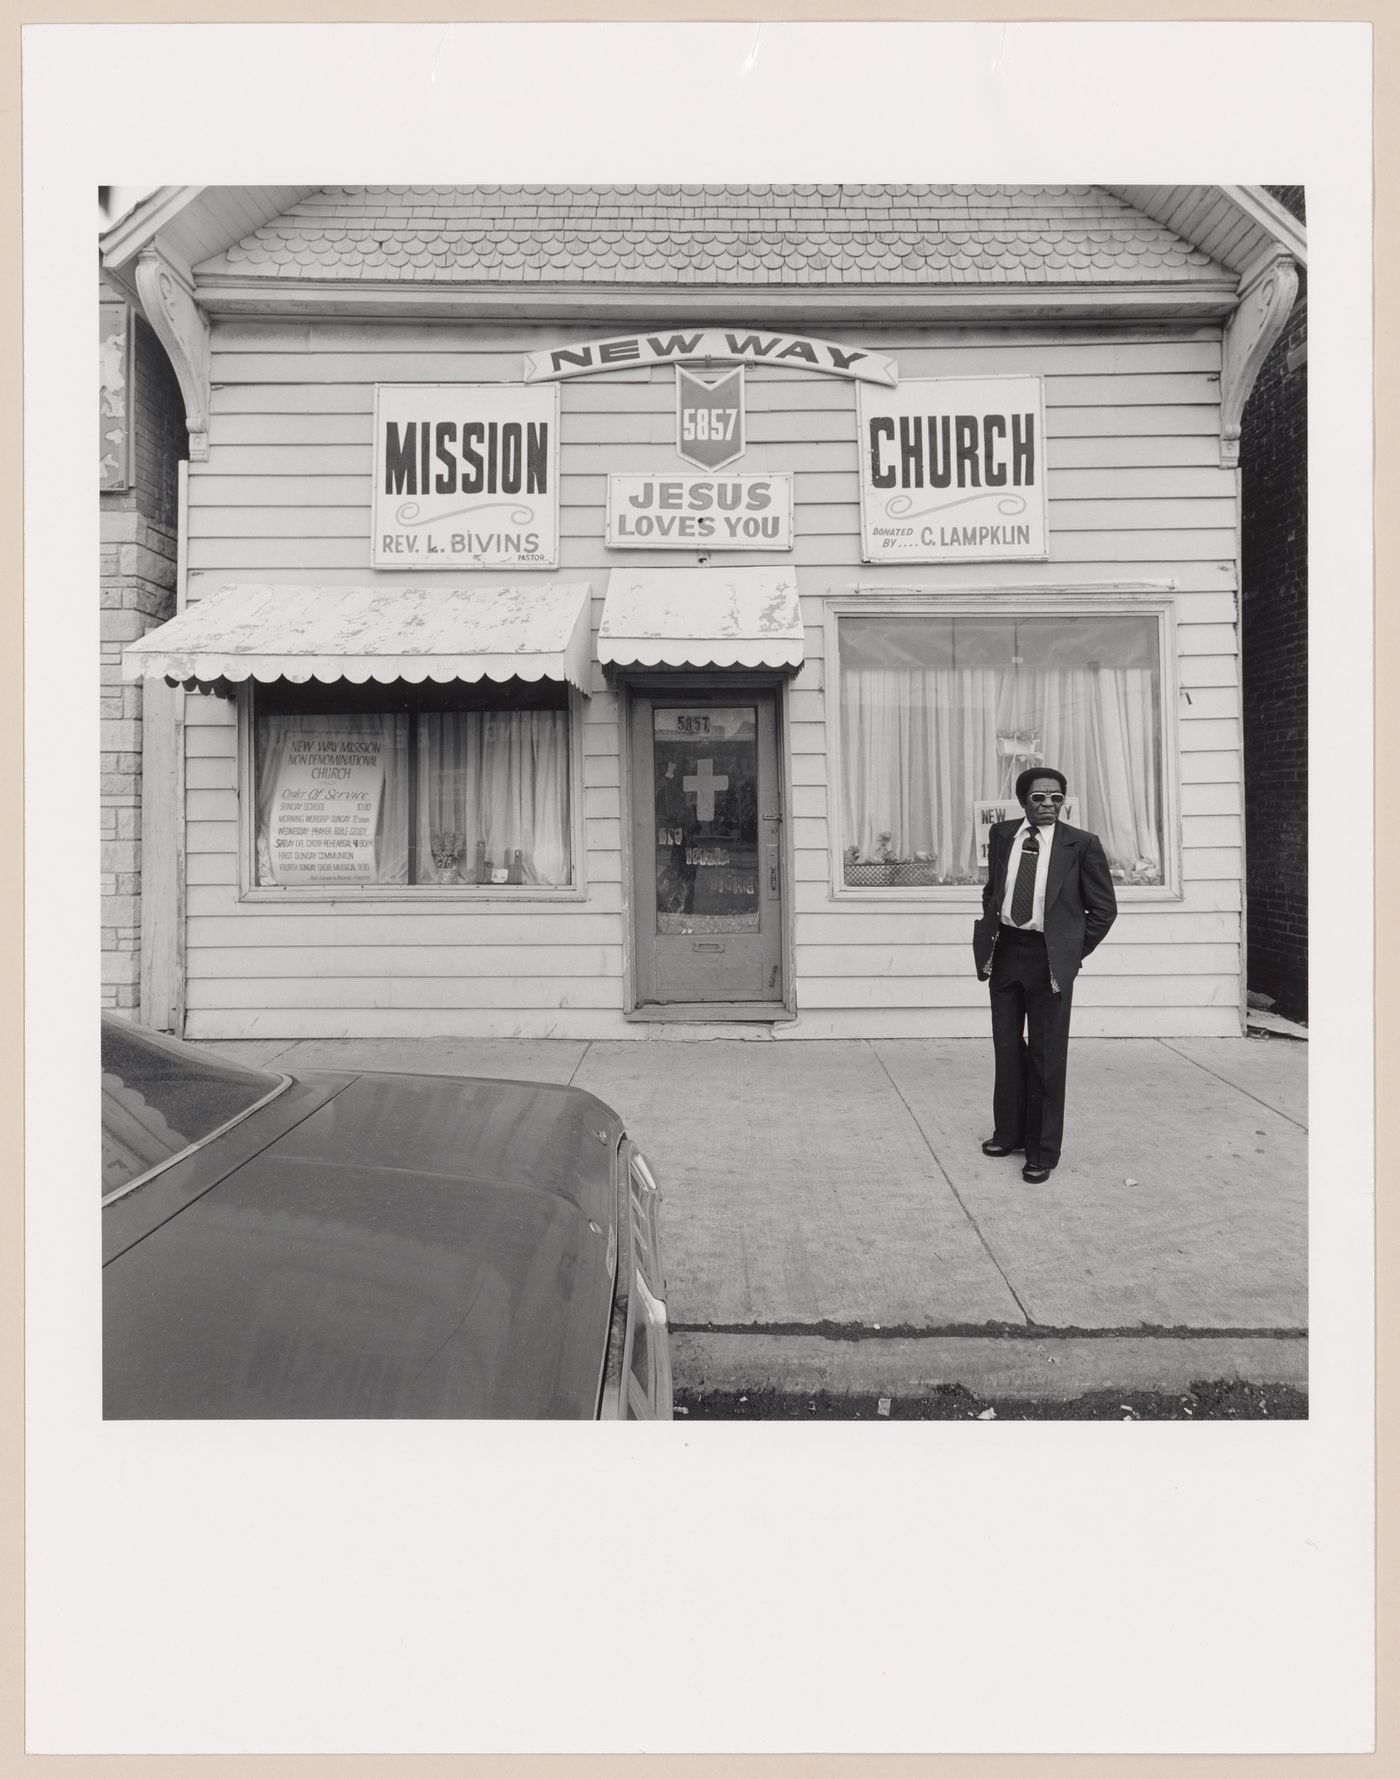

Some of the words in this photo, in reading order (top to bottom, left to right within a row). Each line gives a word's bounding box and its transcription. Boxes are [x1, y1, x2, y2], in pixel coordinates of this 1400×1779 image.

[551, 334, 704, 372] NEW
[724, 334, 869, 370] WAY
[683, 408, 738, 441] 5857
[385, 421, 548, 496] MISSION
[869, 413, 1034, 489] CHURCH
[628, 482, 772, 511] JESUS
[618, 514, 716, 537] LOVES
[724, 516, 780, 538] YOU
[872, 528, 914, 536] DONATED
[382, 534, 419, 553] REV.
[427, 534, 445, 553] L.
[451, 533, 540, 553] BIVINS
[921, 526, 936, 546] C.
[940, 525, 1030, 546] LAMPKLIN
[678, 716, 711, 733] 5857
[291, 741, 312, 753] NEW
[318, 741, 338, 753] WAY
[340, 741, 382, 754] MISSION
[288, 754, 307, 766] NON
[311, 767, 352, 780] CHURCH
[282, 789, 307, 800] Order
[308, 788, 324, 801] Of
[325, 788, 369, 800] Service
[280, 802, 302, 811] SUNDAY
[303, 802, 325, 811] SCHOOL
[278, 815, 304, 823] MORNING
[305, 815, 330, 823] WORSHIP
[331, 815, 351, 823] SUNDAY
[981, 808, 1006, 825] NEW
[278, 827, 309, 836] WEDNESDAY
[334, 827, 348, 836] BIBLE
[349, 827, 367, 836] STUDY
[323, 839, 352, 848] REHEARSAL
[278, 851, 293, 860] FIRST
[294, 851, 317, 860] SUNDAY
[318, 851, 354, 860] COMMUNION
